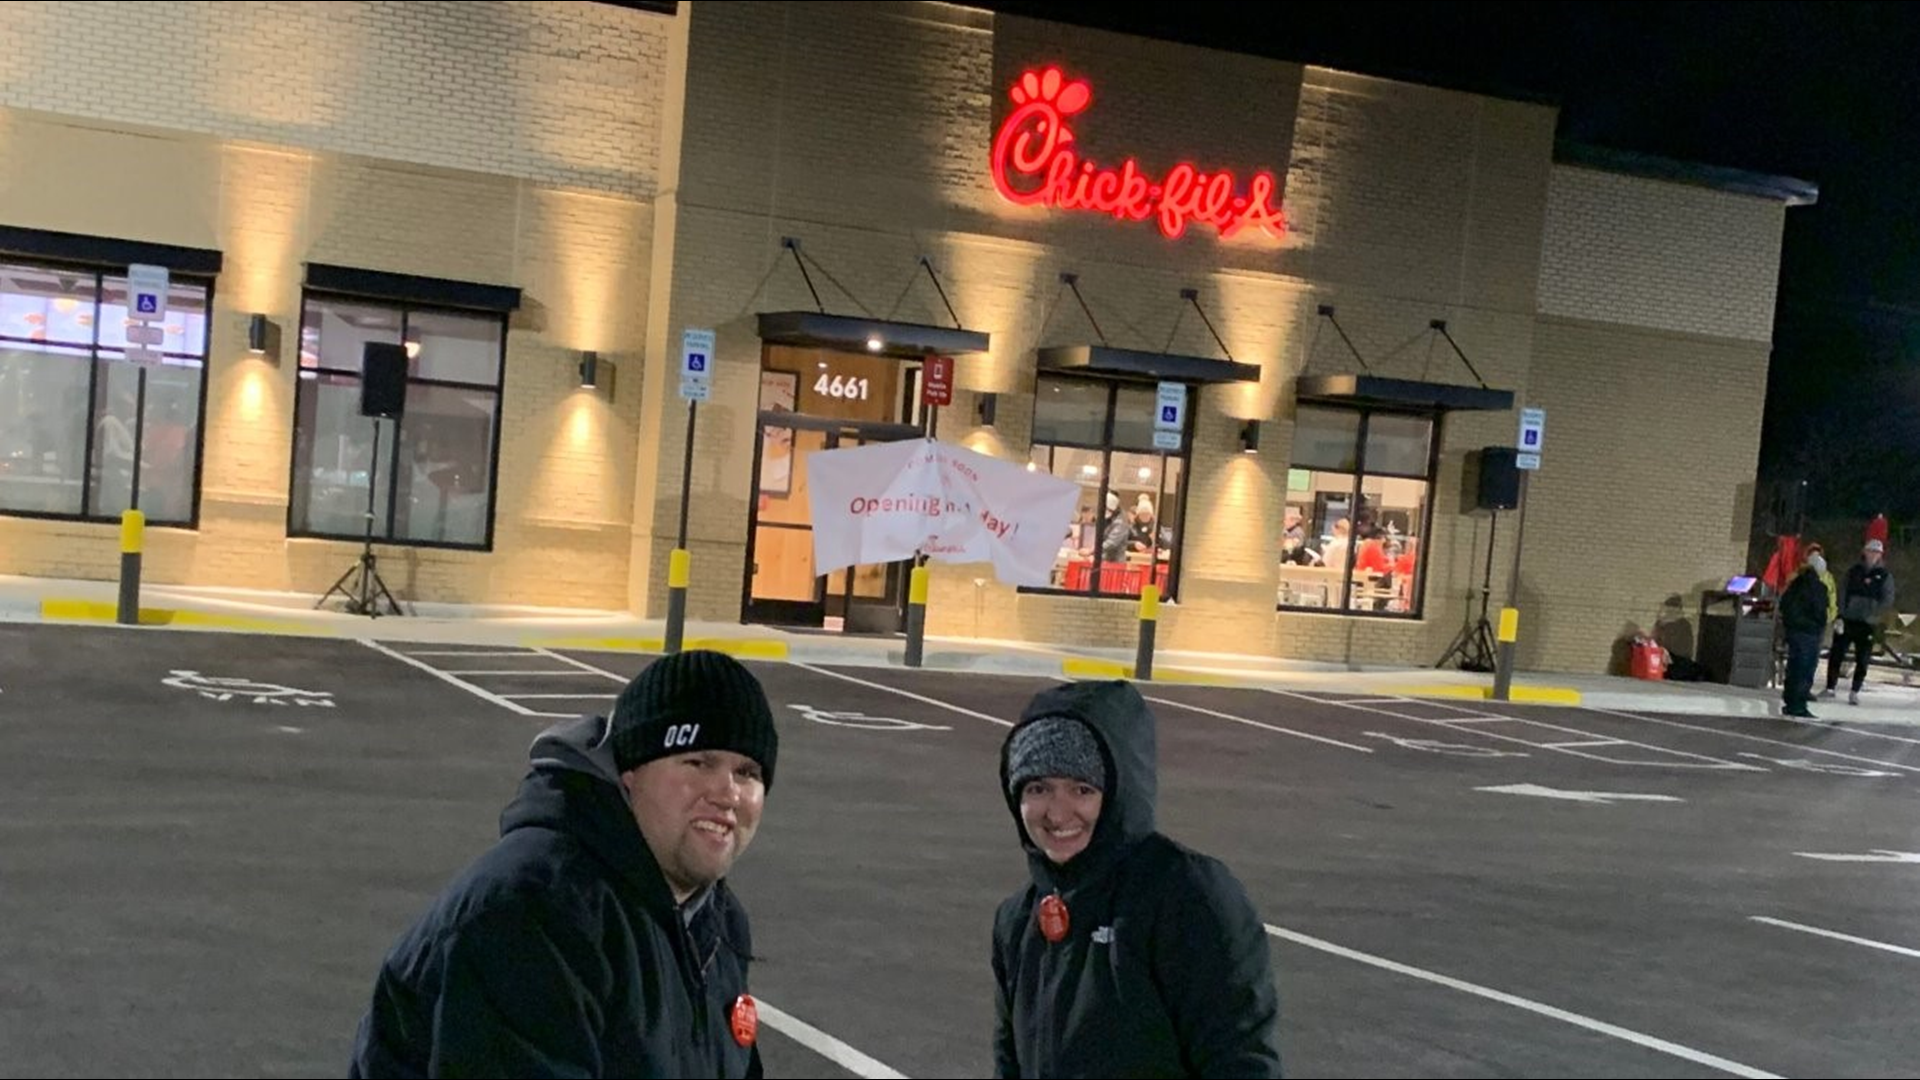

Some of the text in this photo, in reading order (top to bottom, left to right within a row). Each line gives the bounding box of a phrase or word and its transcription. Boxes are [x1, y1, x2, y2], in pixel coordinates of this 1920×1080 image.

[991, 69, 1288, 240] Chick-fil-A
[813, 373, 869, 401] 4661
[850, 493, 941, 517] Opening
[664, 723, 700, 748] OCI
